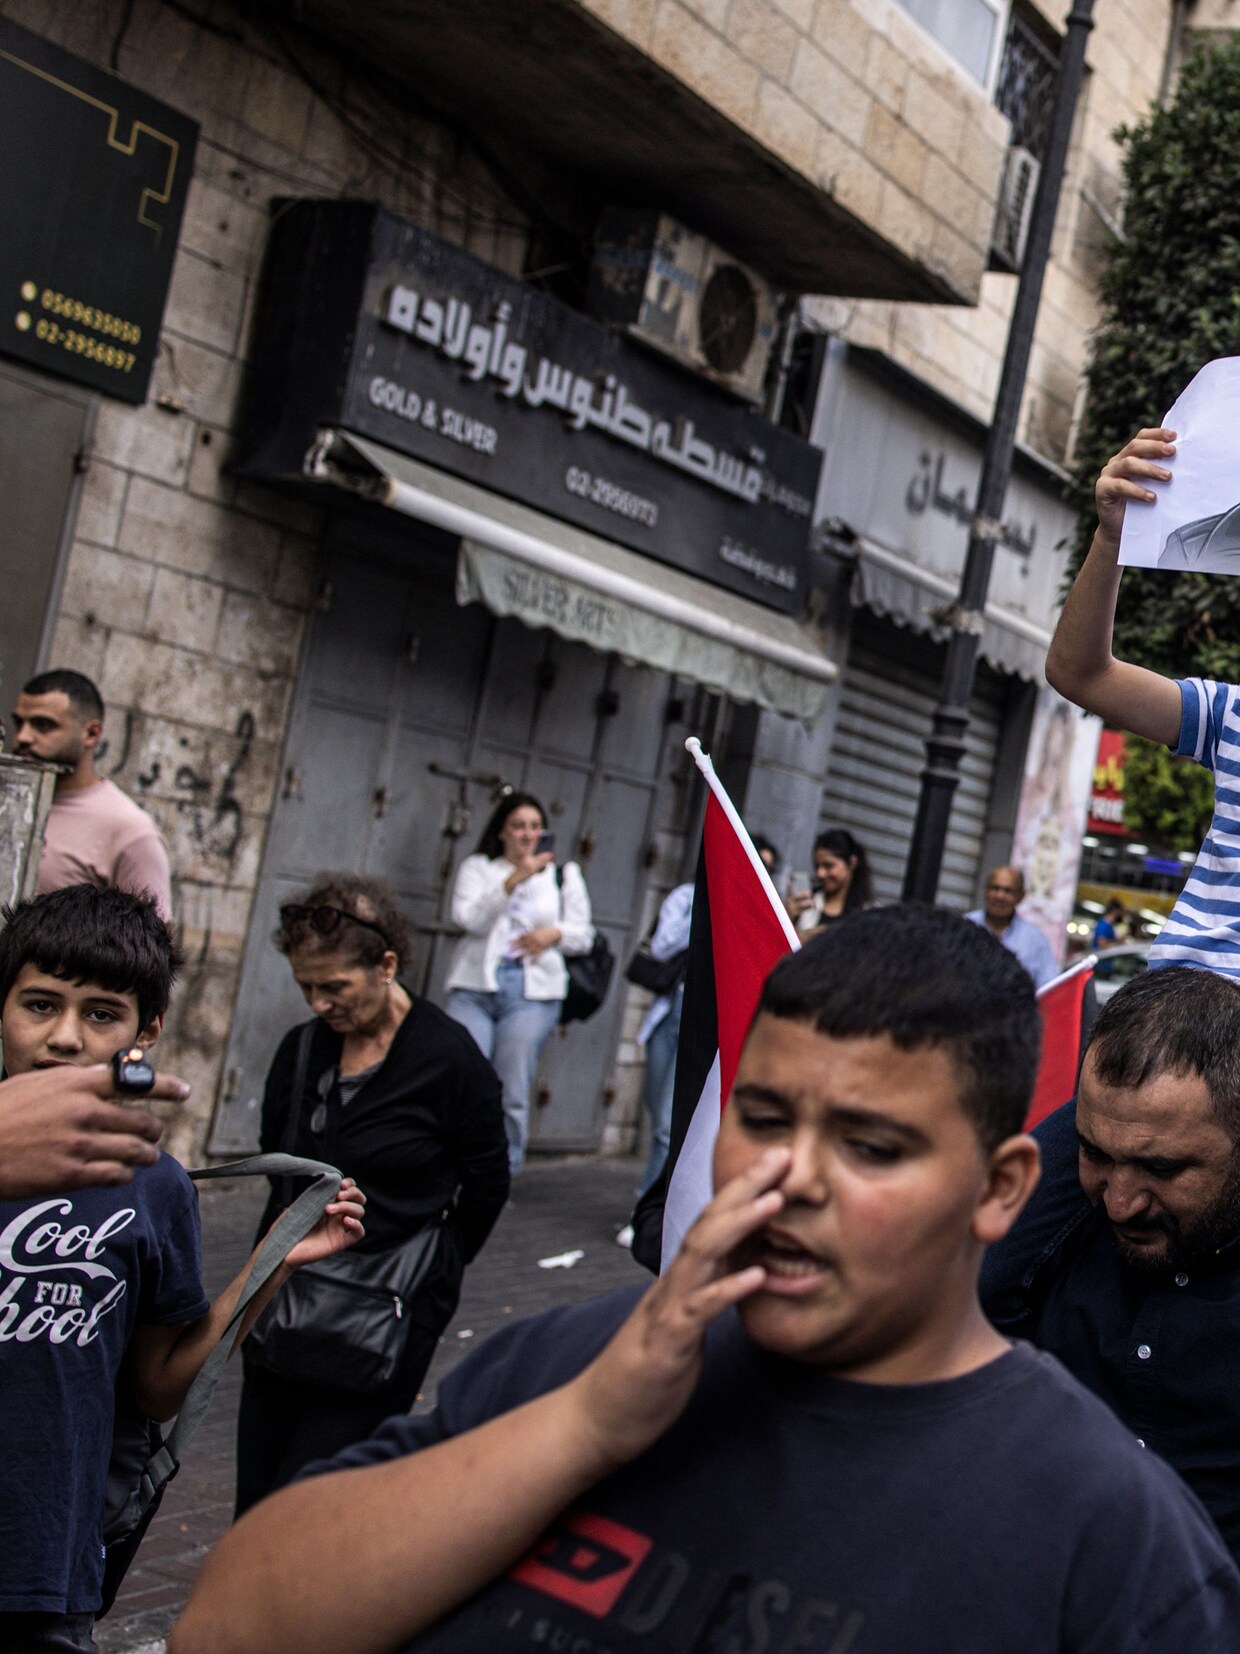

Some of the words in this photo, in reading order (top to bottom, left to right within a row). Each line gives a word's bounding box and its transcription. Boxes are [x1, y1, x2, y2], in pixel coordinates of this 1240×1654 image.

[386, 285, 527, 396] وأولاده
[369, 377, 421, 420] GOLD
[421, 405, 438, 429] &
[438, 408, 498, 456] SILVER
[0, 1198, 136, 1280] Cool
[0, 1276, 127, 1347] hool
[34, 1281, 83, 1306] FOR
